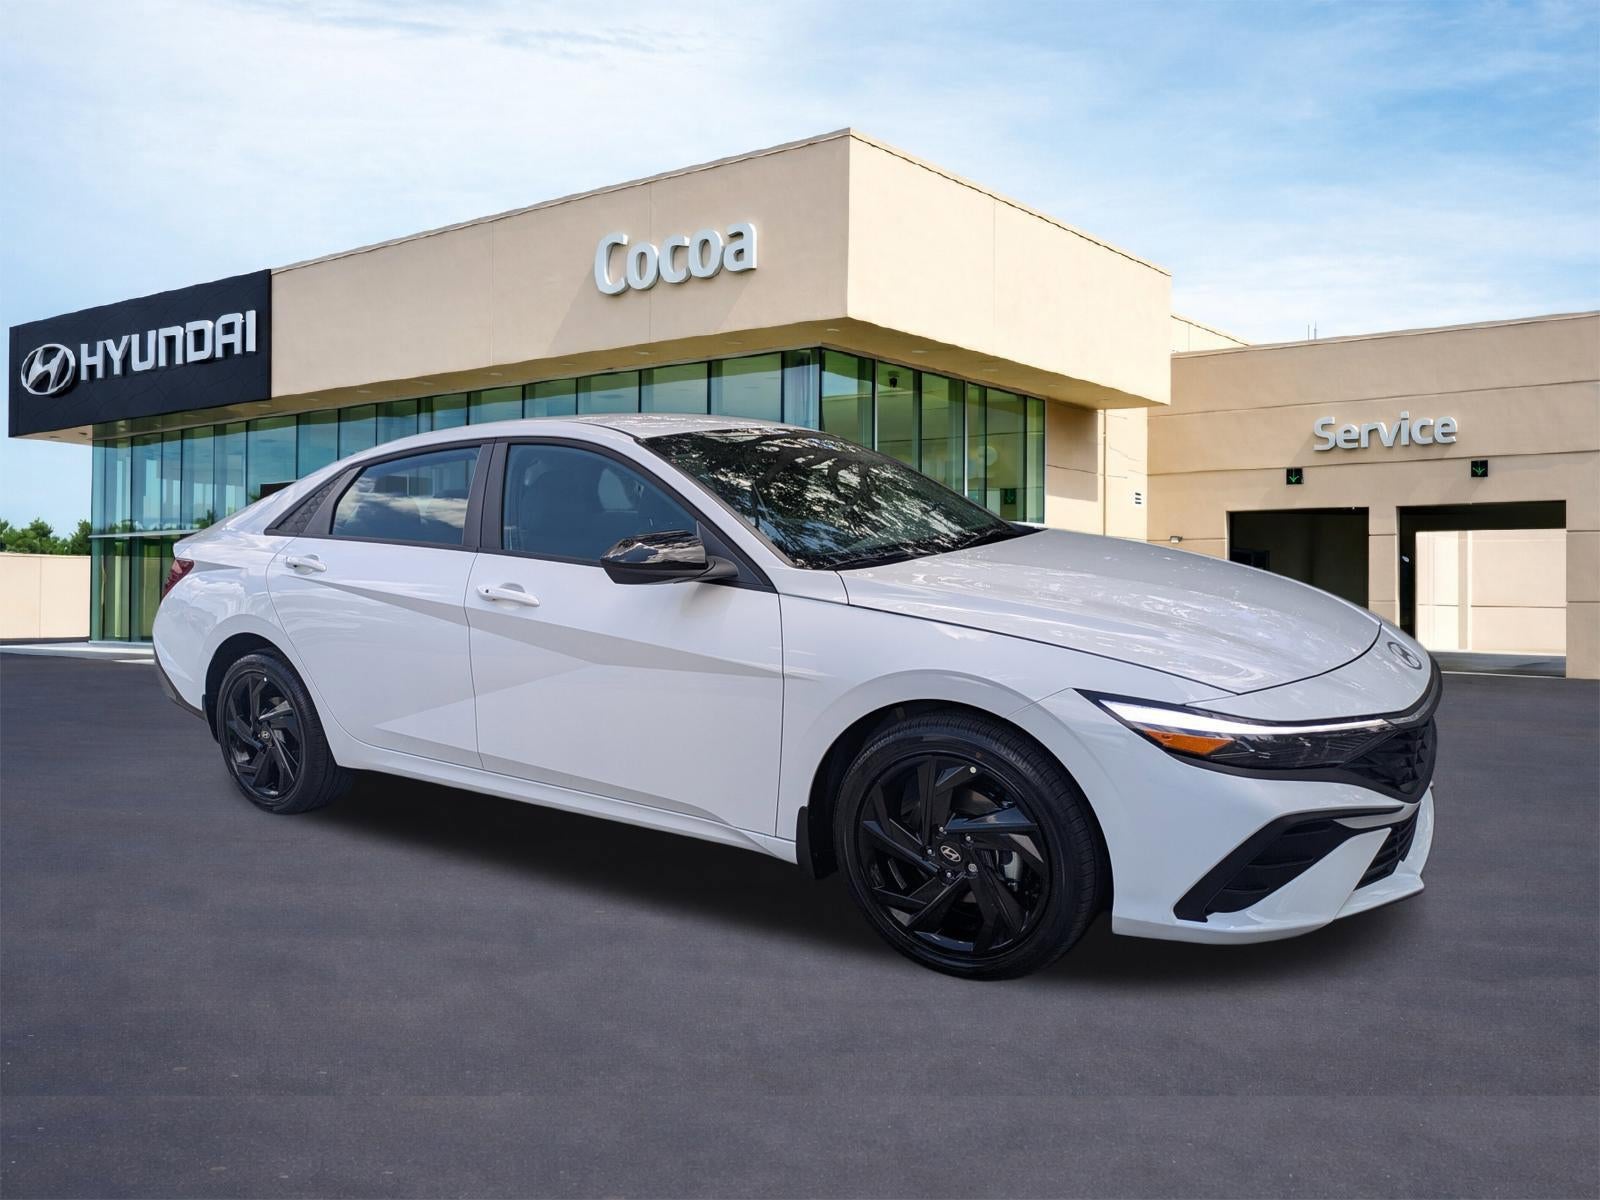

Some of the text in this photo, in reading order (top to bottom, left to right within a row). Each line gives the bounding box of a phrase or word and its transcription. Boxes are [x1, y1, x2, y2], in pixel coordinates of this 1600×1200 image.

[594, 223, 757, 295] Cocoa
[80, 310, 256, 381] HYUNDAI
[1313, 411, 1458, 451] Service
